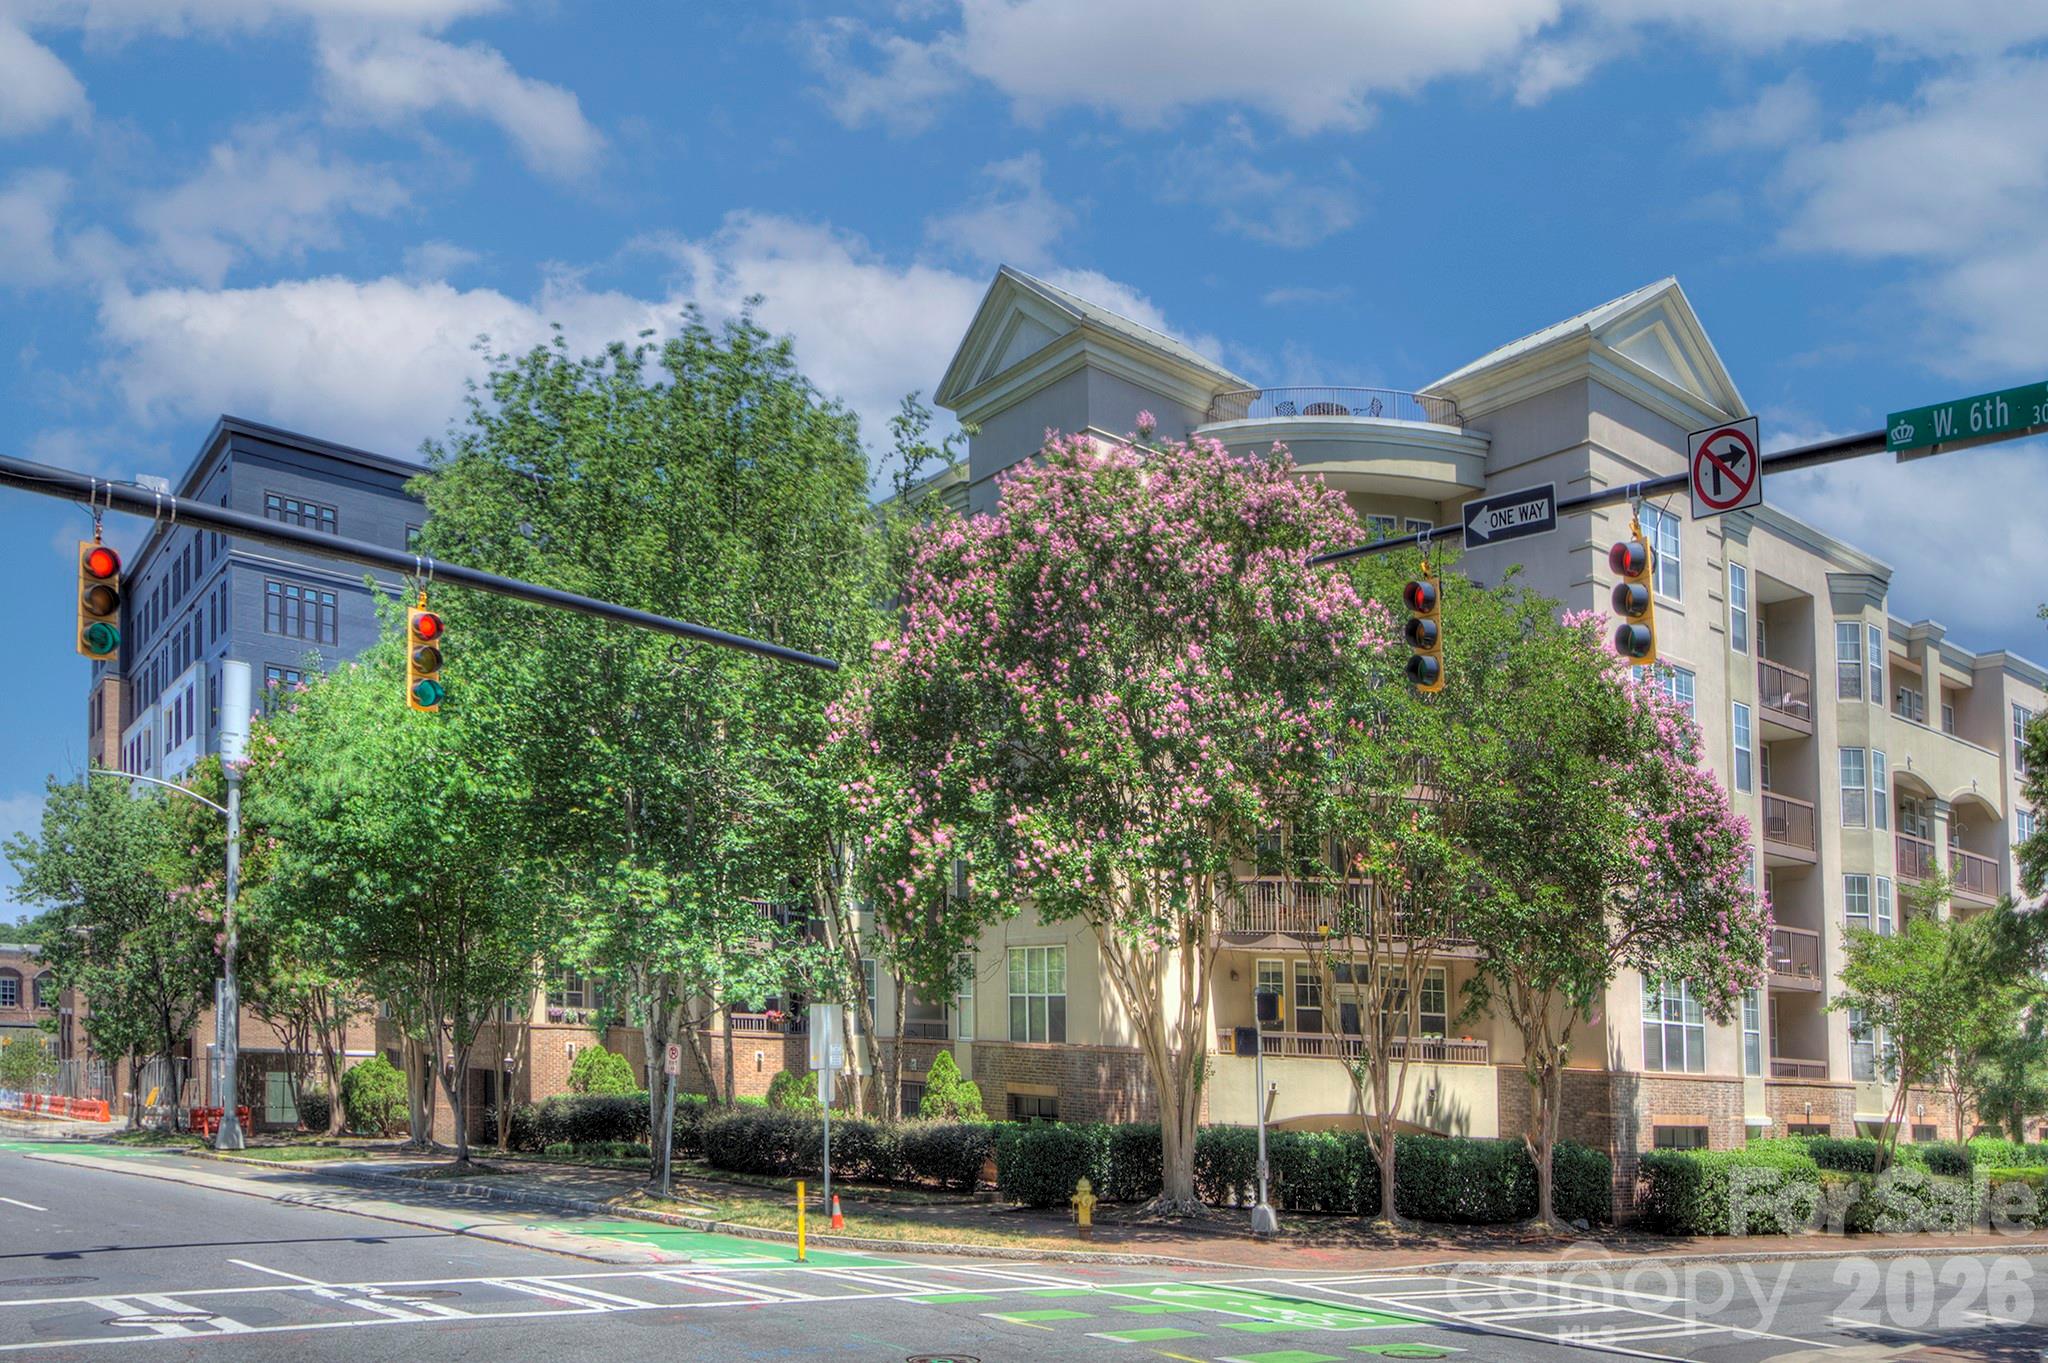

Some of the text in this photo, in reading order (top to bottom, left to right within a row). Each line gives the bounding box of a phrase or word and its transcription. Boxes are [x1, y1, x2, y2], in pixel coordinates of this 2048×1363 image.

[1933, 407, 1958, 438] W.
[1970, 396, 2009, 432] 6th
[1490, 502, 1545, 529] ONE WAY
